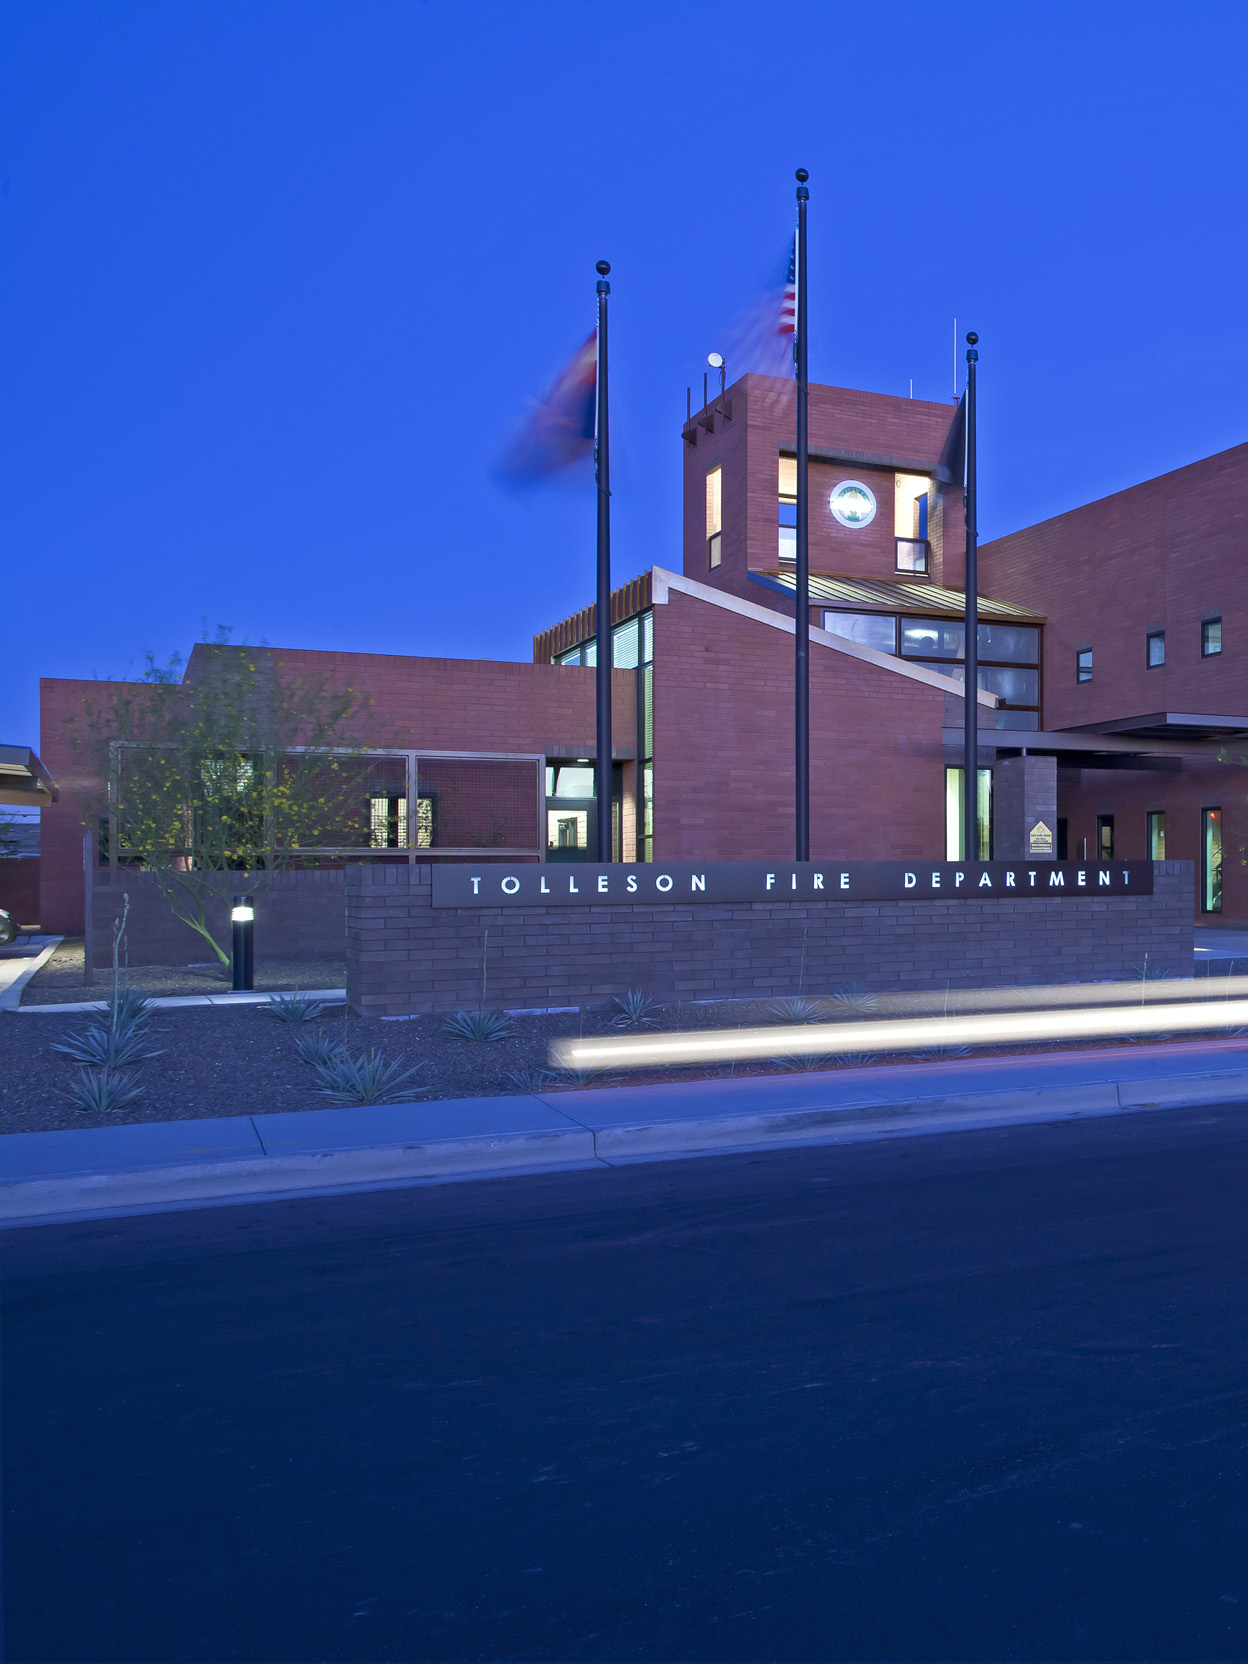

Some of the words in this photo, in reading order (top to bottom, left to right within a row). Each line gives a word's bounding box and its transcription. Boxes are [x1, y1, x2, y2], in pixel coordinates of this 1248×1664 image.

[470, 874, 706, 895] TOLLESON
[765, 872, 850, 891] FIRE
[904, 870, 1130, 889] DEPARTMENT
